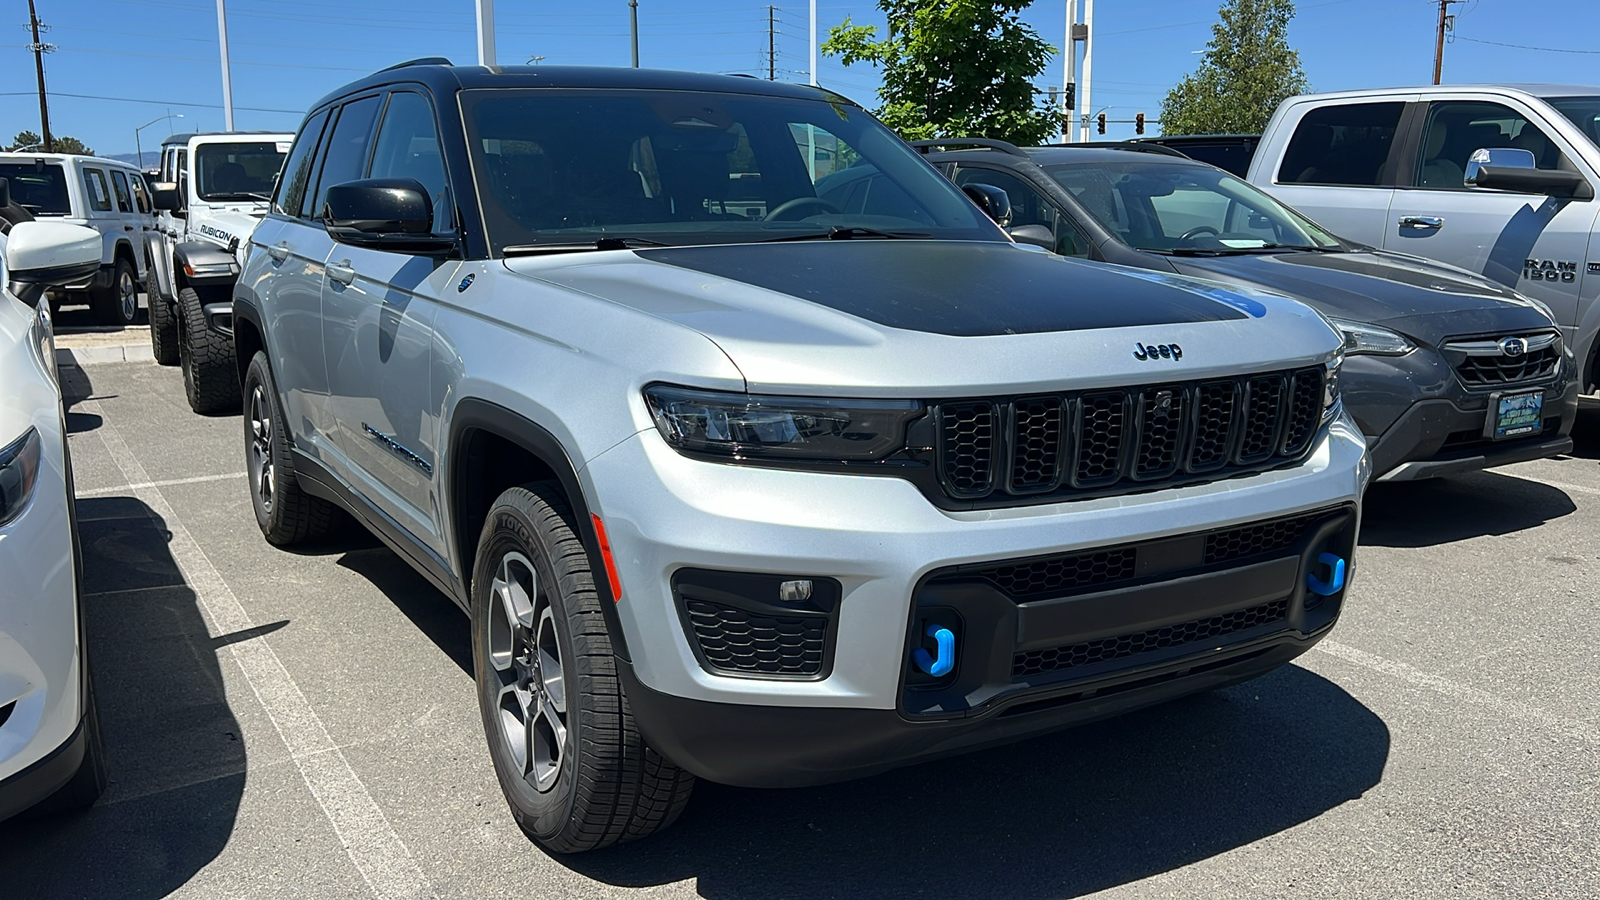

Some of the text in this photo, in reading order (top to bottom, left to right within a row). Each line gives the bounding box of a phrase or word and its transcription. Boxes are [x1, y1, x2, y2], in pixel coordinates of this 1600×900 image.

[200, 224, 232, 241] RUBICON
[1524, 258, 1577, 272] RAM
[1523, 268, 1576, 283] 1500
[1132, 342, 1183, 361] Jeep
[501, 515, 529, 538] TOYO
